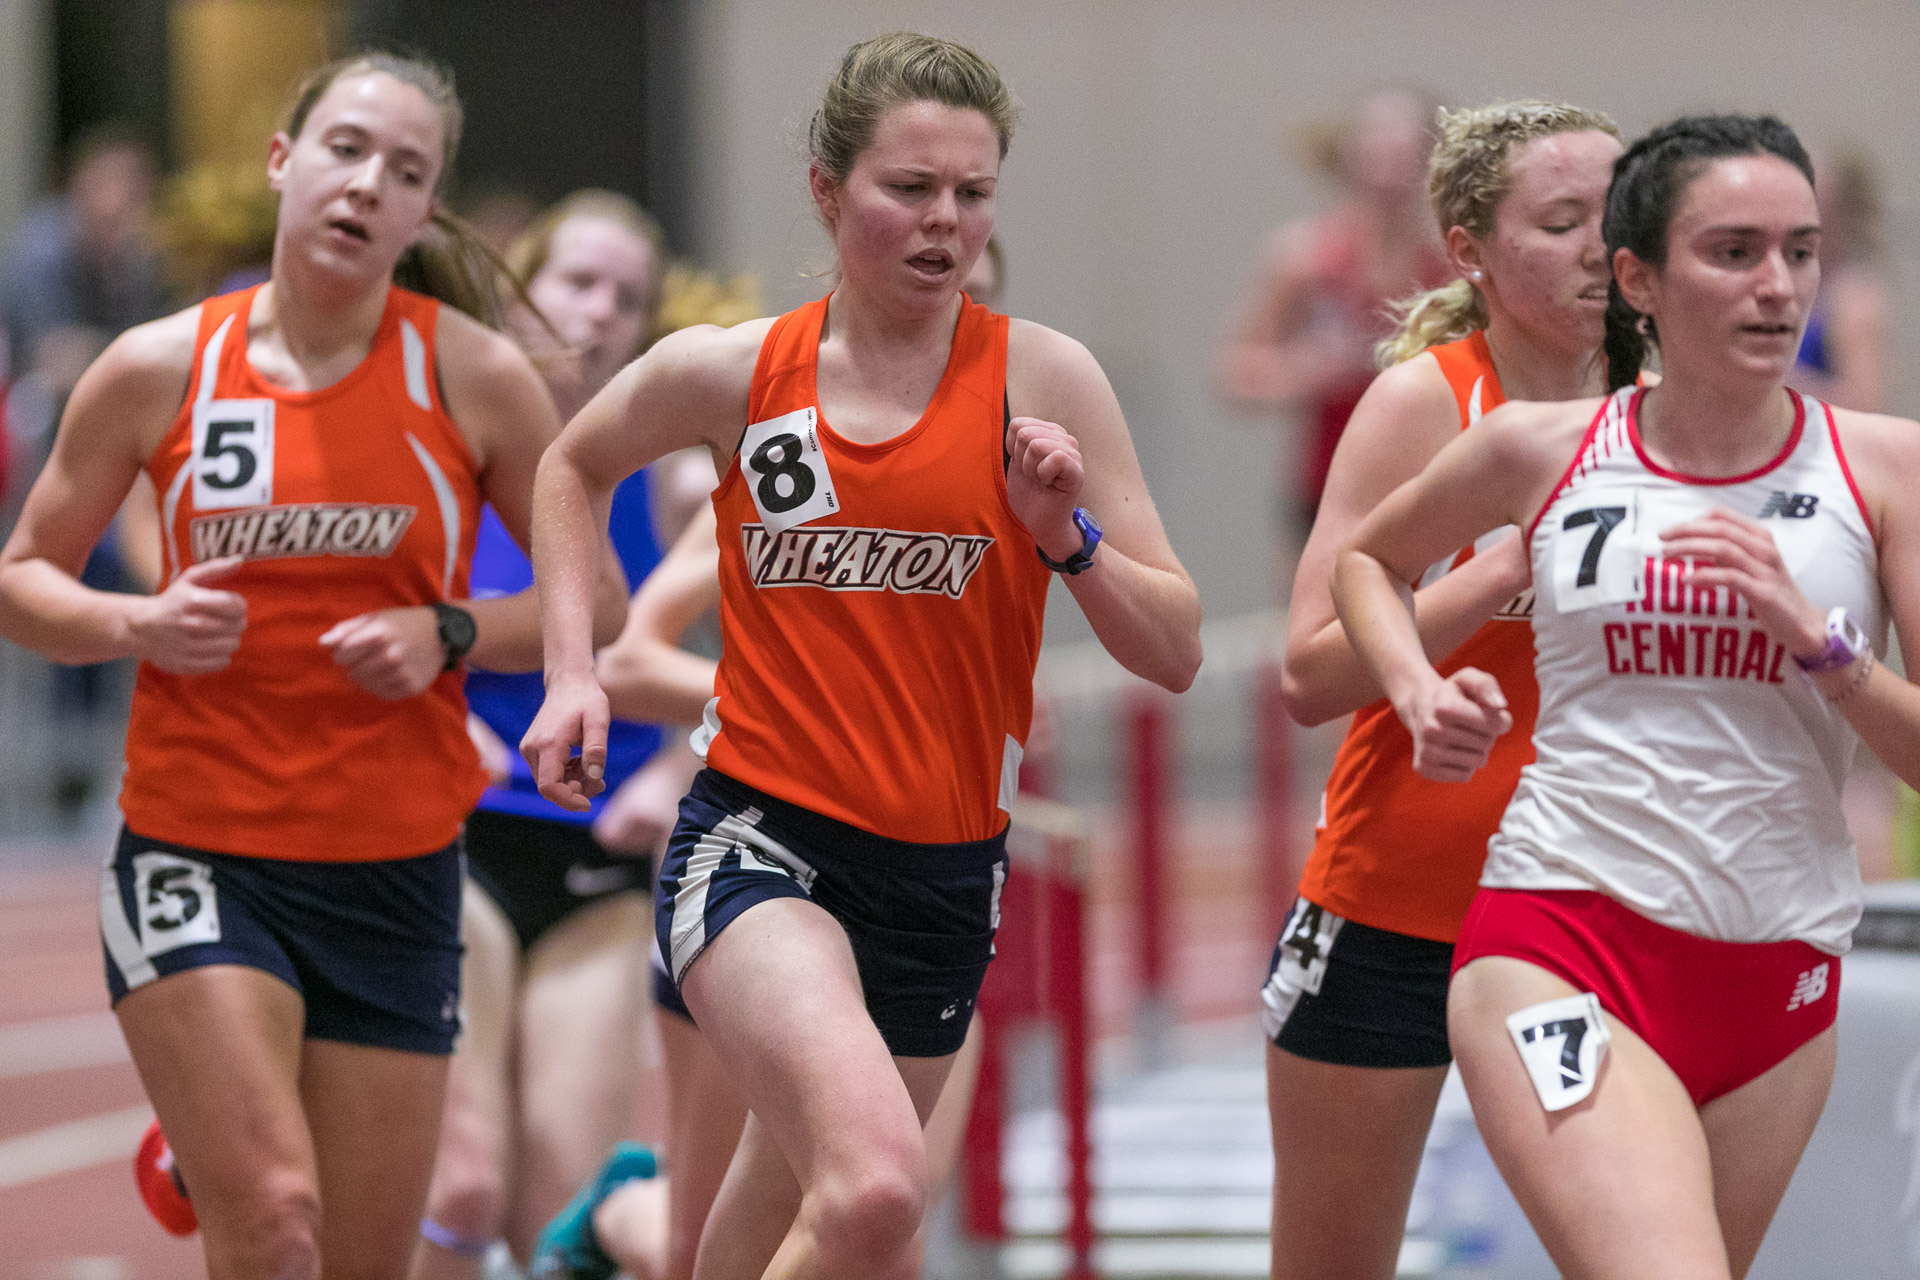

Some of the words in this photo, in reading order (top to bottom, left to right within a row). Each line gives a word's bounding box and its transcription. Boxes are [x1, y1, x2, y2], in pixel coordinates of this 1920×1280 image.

[200, 420, 258, 491] 5
[749, 432, 816, 513] 8
[190, 503, 417, 560] WHEATON
[1758, 491, 1820, 519] NB
[741, 523, 996, 600] WHEATON
[1562, 506, 1626, 588] 7
[1603, 622, 1786, 684] CENTRAL
[147, 866, 201, 931] 5
[1285, 901, 1321, 970] 4
[1522, 1016, 1588, 1089] 7
